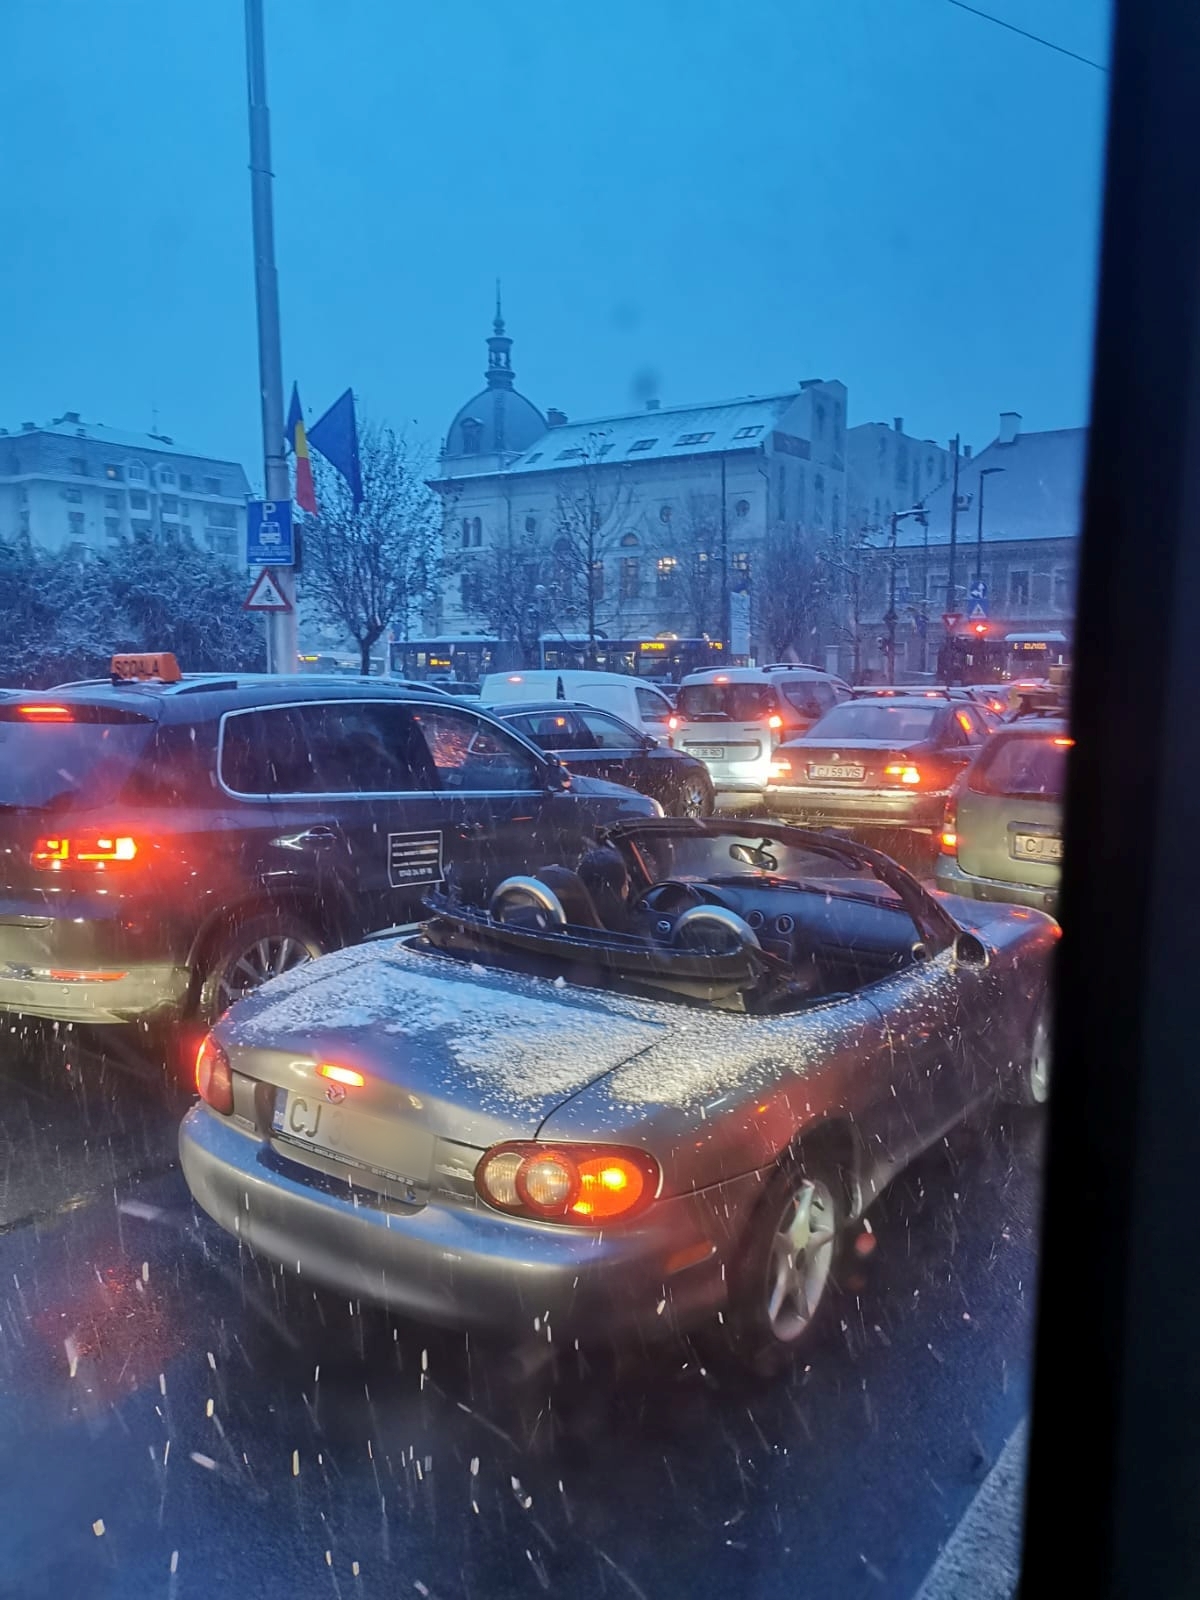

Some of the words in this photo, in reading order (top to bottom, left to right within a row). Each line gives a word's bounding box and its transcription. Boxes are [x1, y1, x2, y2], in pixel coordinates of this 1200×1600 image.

[262, 502, 277, 521] P
[817, 767, 829, 777] CJ
[831, 767, 843, 777] 59
[1025, 838, 1044, 854] CJ
[289, 1098, 322, 1138] CJ
